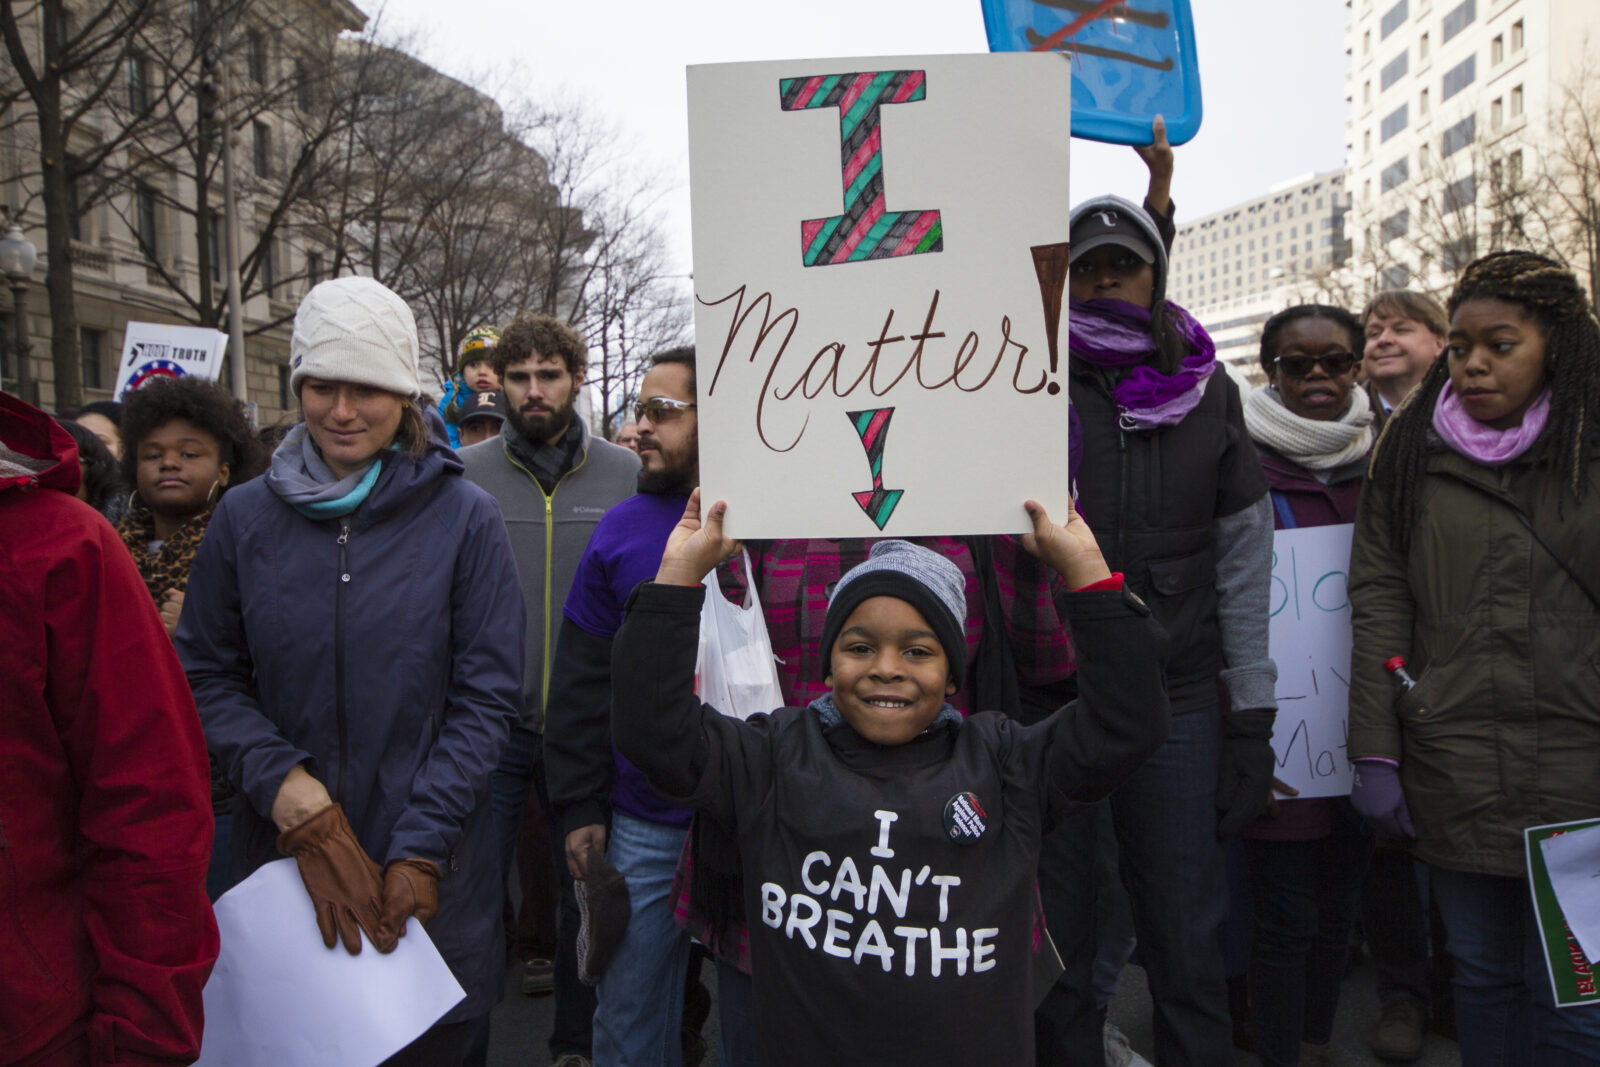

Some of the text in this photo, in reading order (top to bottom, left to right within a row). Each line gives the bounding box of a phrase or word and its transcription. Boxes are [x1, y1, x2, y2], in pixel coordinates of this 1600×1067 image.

[779, 69, 943, 267] I
[172, 346, 207, 362] TRUTH
[696, 241, 1070, 453] Matter!
[870, 809, 899, 858] I
[952, 800, 971, 823] Against
[967, 819, 982, 838] Police
[953, 811, 973, 837] Violence!
[957, 794, 976, 818] National
[972, 813, 986, 833] March
[801, 850, 962, 923] CAN'T
[761, 882, 999, 978] BREATHE
